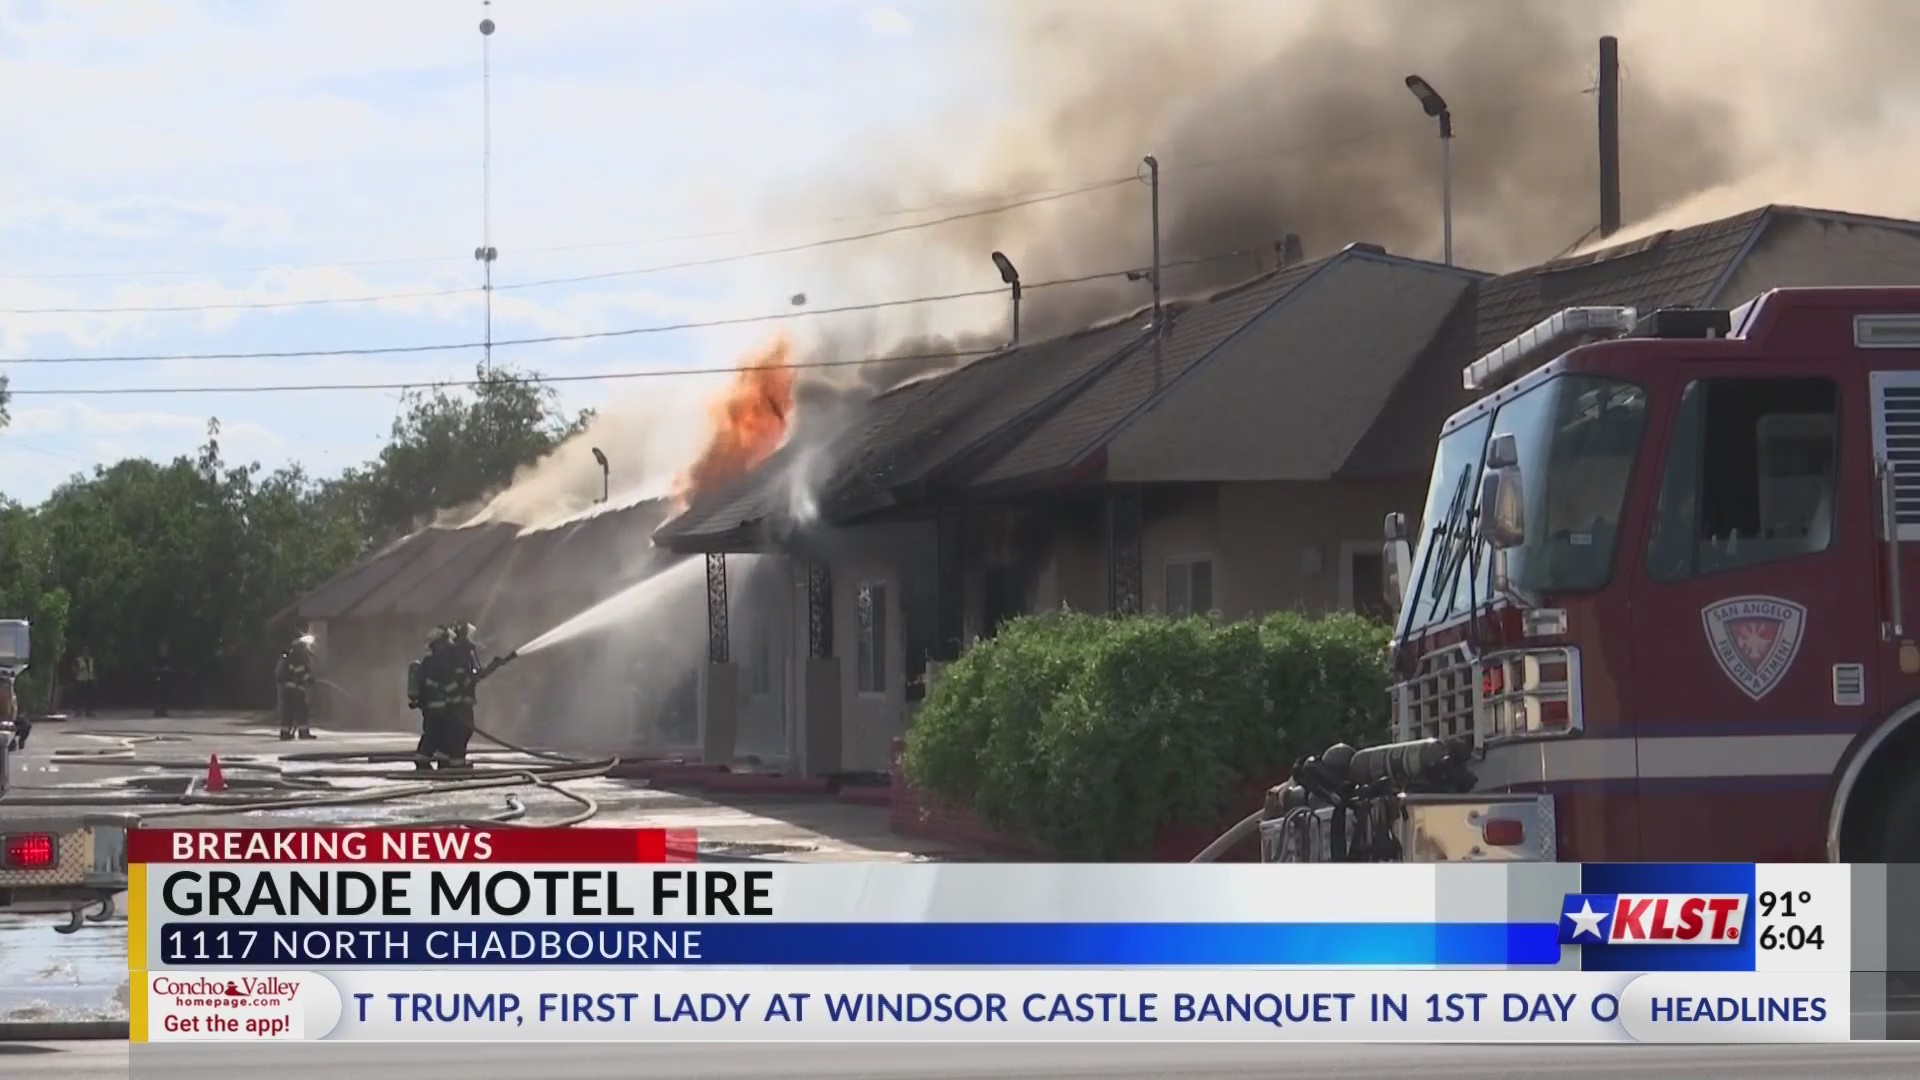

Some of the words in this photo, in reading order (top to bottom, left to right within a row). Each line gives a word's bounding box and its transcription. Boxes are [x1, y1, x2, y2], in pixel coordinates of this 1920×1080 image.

[1713, 606, 1738, 621] SAN
[1743, 602, 1792, 620] ANGELO
[1718, 639, 1736, 662] FIRE
[1733, 638, 1792, 689] DEPARTMENT
